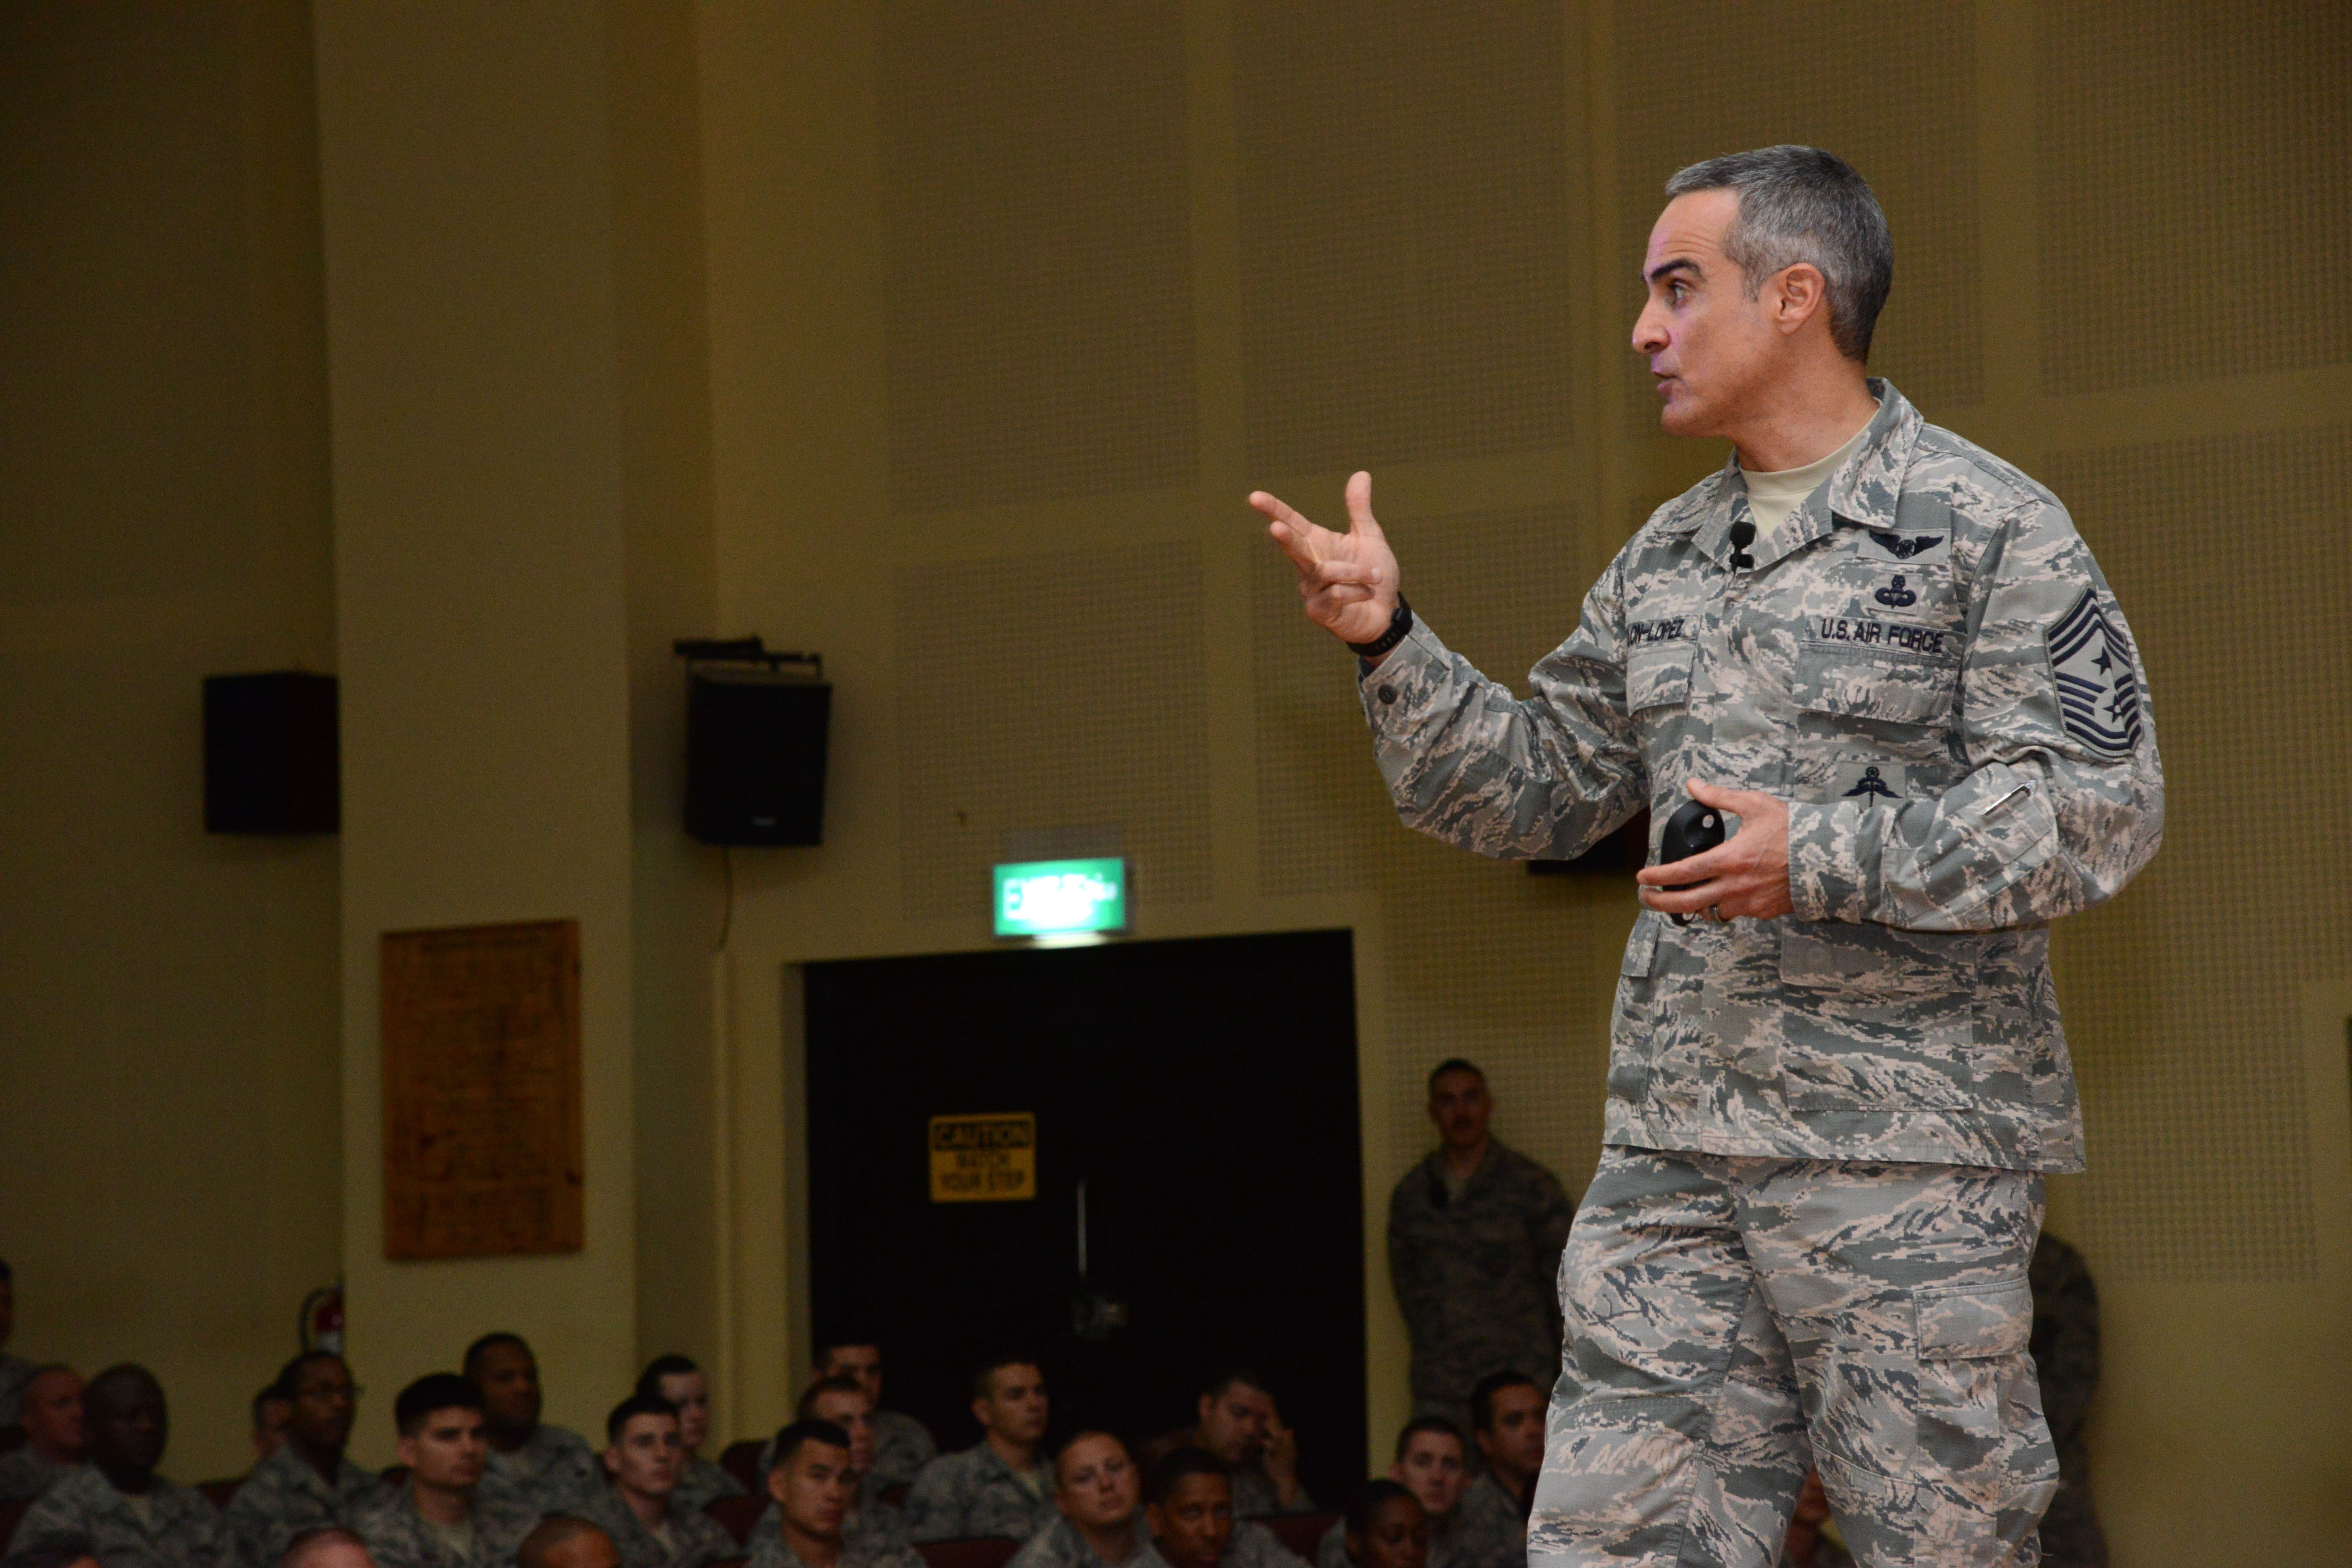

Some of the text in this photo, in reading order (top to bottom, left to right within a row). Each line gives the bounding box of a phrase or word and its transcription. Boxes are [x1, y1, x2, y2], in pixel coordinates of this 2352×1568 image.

[1822, 618, 1944, 653] U.S. AIR FORCE
[935, 1123, 1031, 1148] CAUTION
